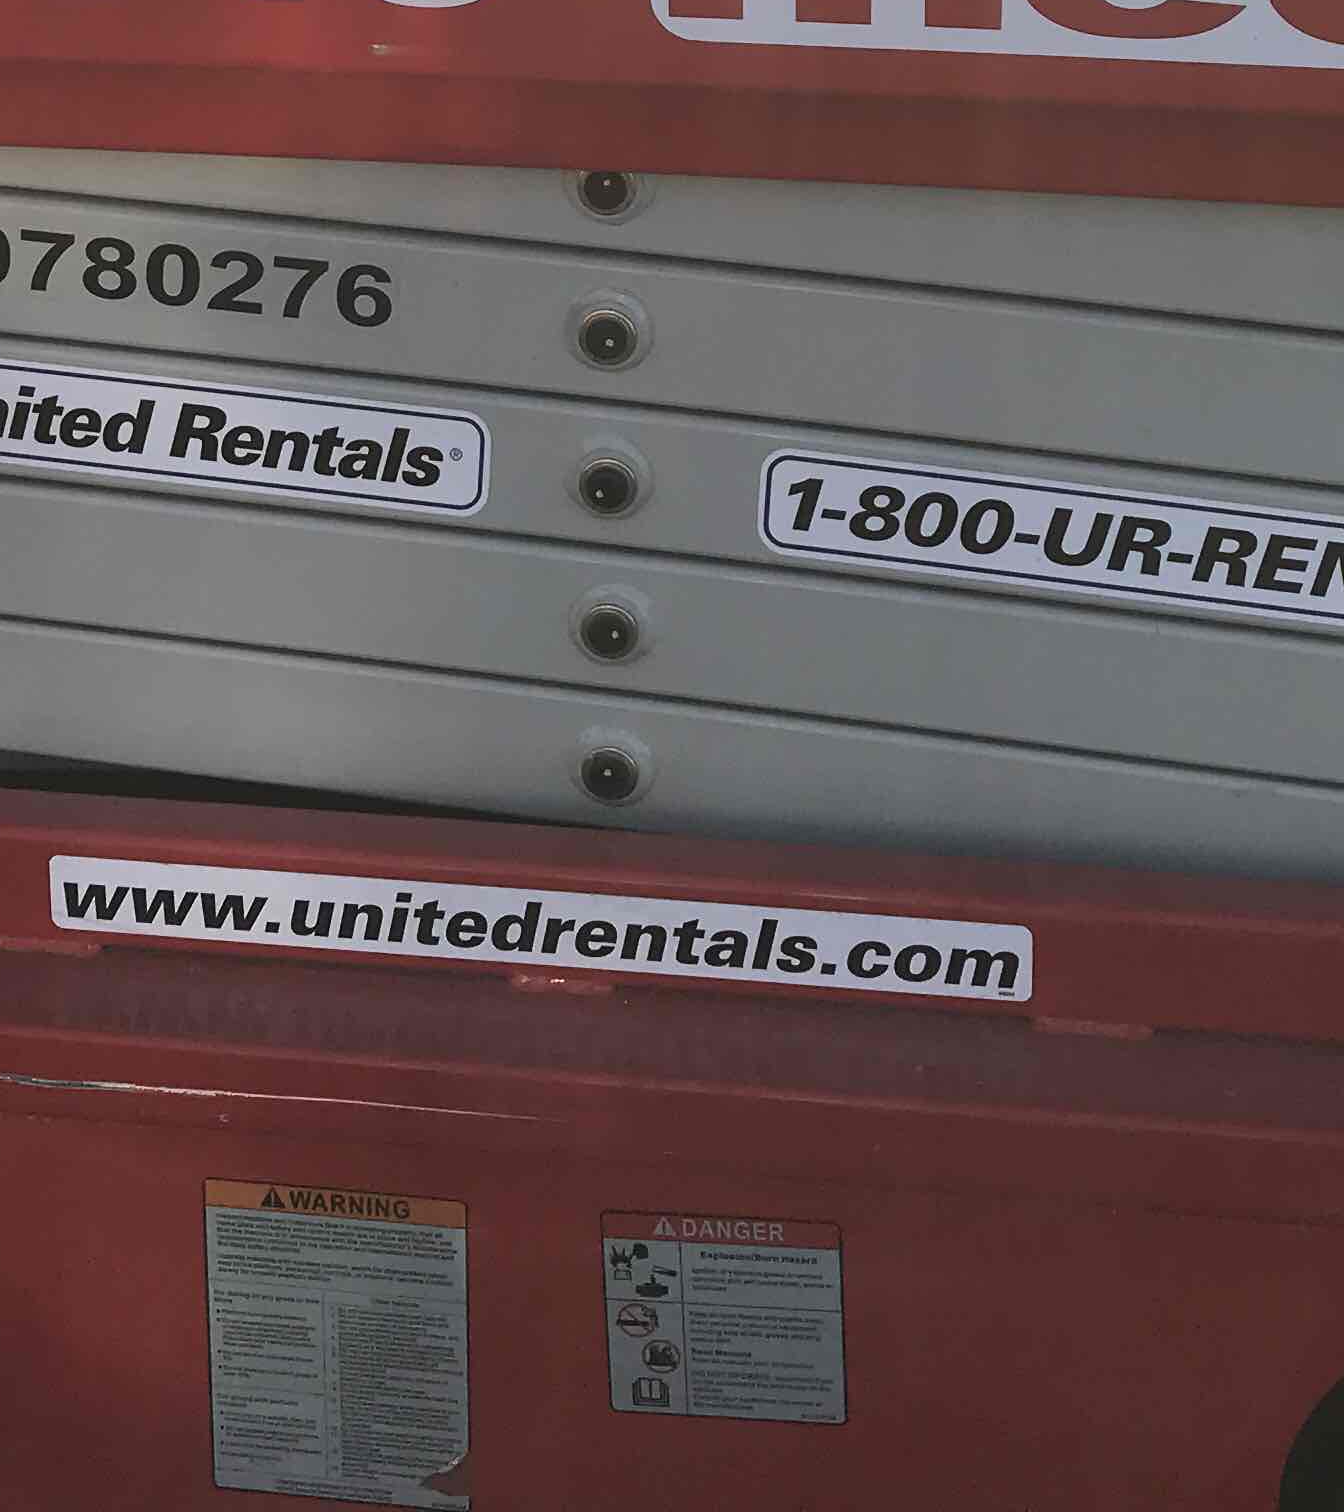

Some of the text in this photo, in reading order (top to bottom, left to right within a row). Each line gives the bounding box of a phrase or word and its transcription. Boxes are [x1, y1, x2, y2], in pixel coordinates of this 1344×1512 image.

[170, 402, 445, 489] Rentals
[62, 881, 1021, 990] www.unitedrentals.com
[288, 1189, 411, 1219] WARNING
[682, 1218, 785, 1242] DANGER
